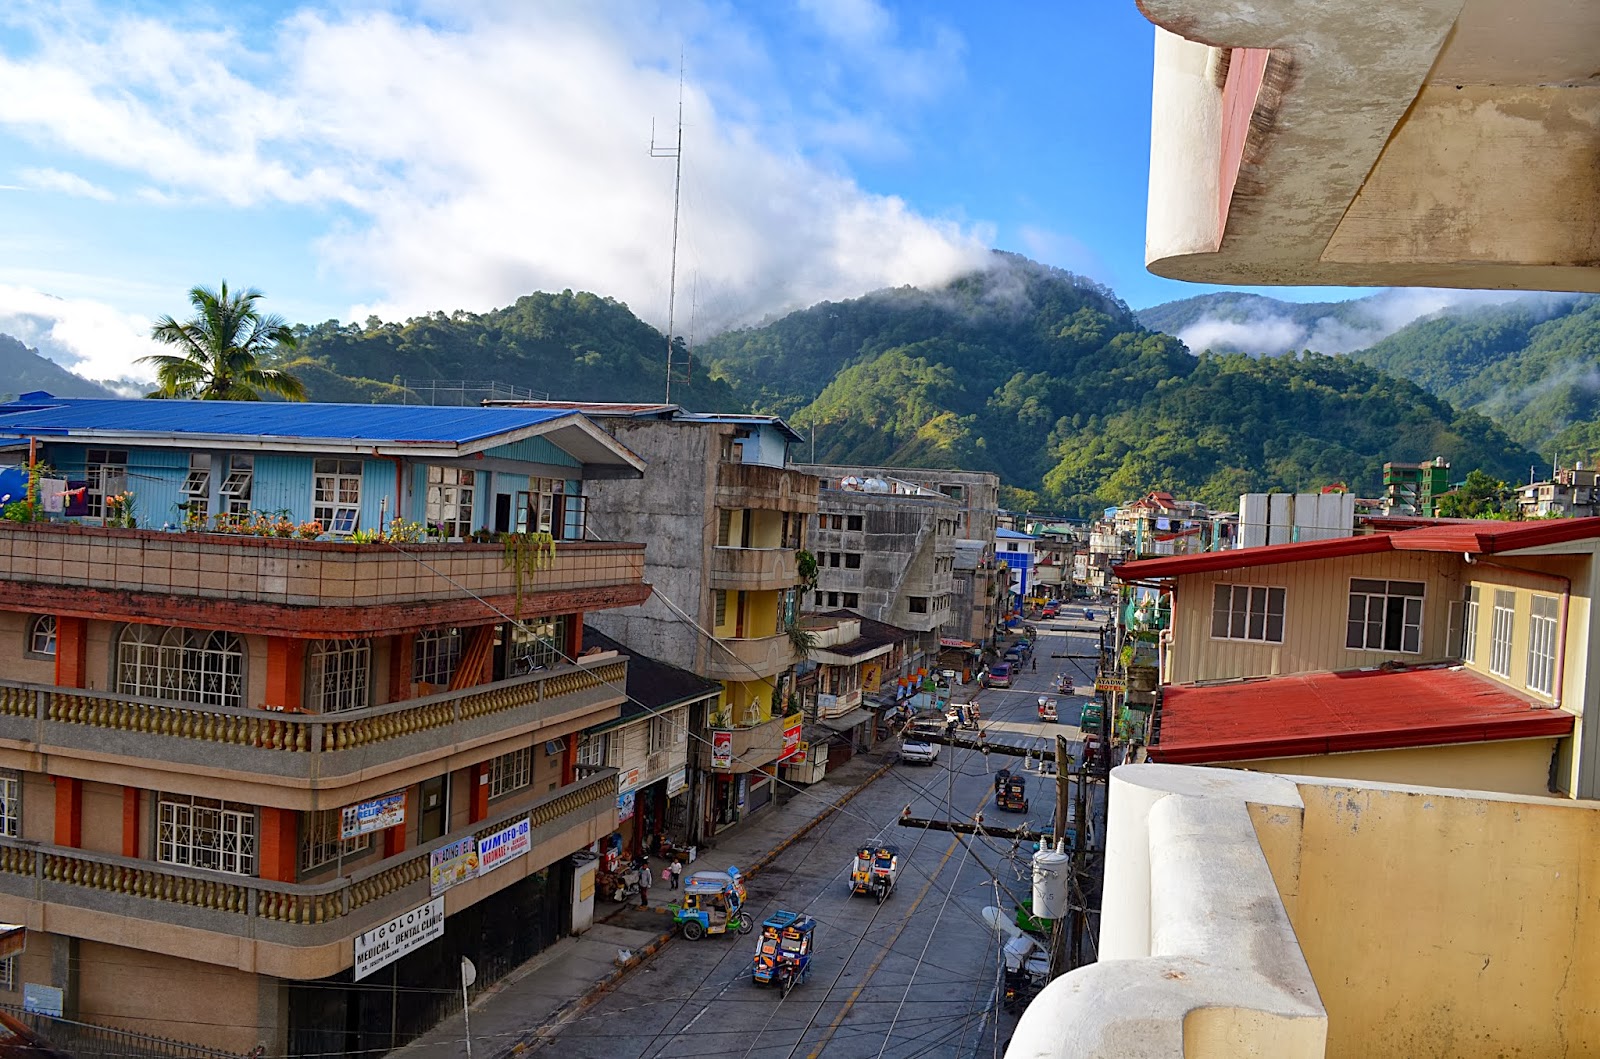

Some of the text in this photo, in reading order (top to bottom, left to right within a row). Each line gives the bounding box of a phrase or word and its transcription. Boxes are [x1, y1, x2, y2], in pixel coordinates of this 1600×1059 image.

[483, 844, 506, 866] HARDWARE
[357, 940, 390, 965] MEDICAL
[395, 924, 420, 945] DENTAL
[421, 912, 443, 932] CLINIC
